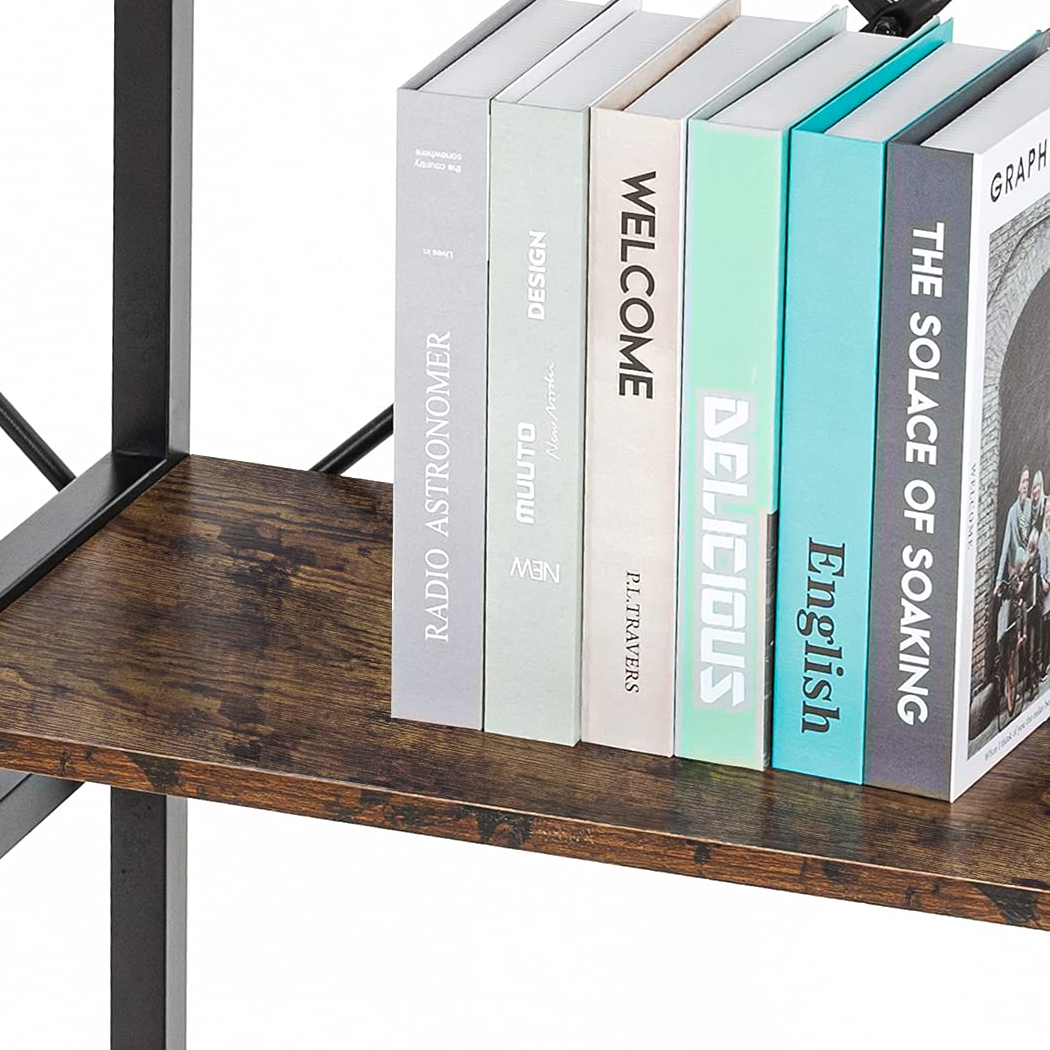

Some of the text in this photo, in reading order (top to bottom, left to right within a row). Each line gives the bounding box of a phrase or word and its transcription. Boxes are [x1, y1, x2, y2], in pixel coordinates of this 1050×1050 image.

[527, 230, 548, 321] DESIGN
[990, 138, 1048, 204] GRAPH
[618, 170, 657, 400] WELCOME
[424, 330, 452, 643] RADIO ASTRONOMER
[509, 556, 561, 584] NEW
[700, 396, 750, 708] DELICIOUS
[896, 221, 945, 726] THE SOLACE OF SOAKING
[796, 536, 847, 735] English
